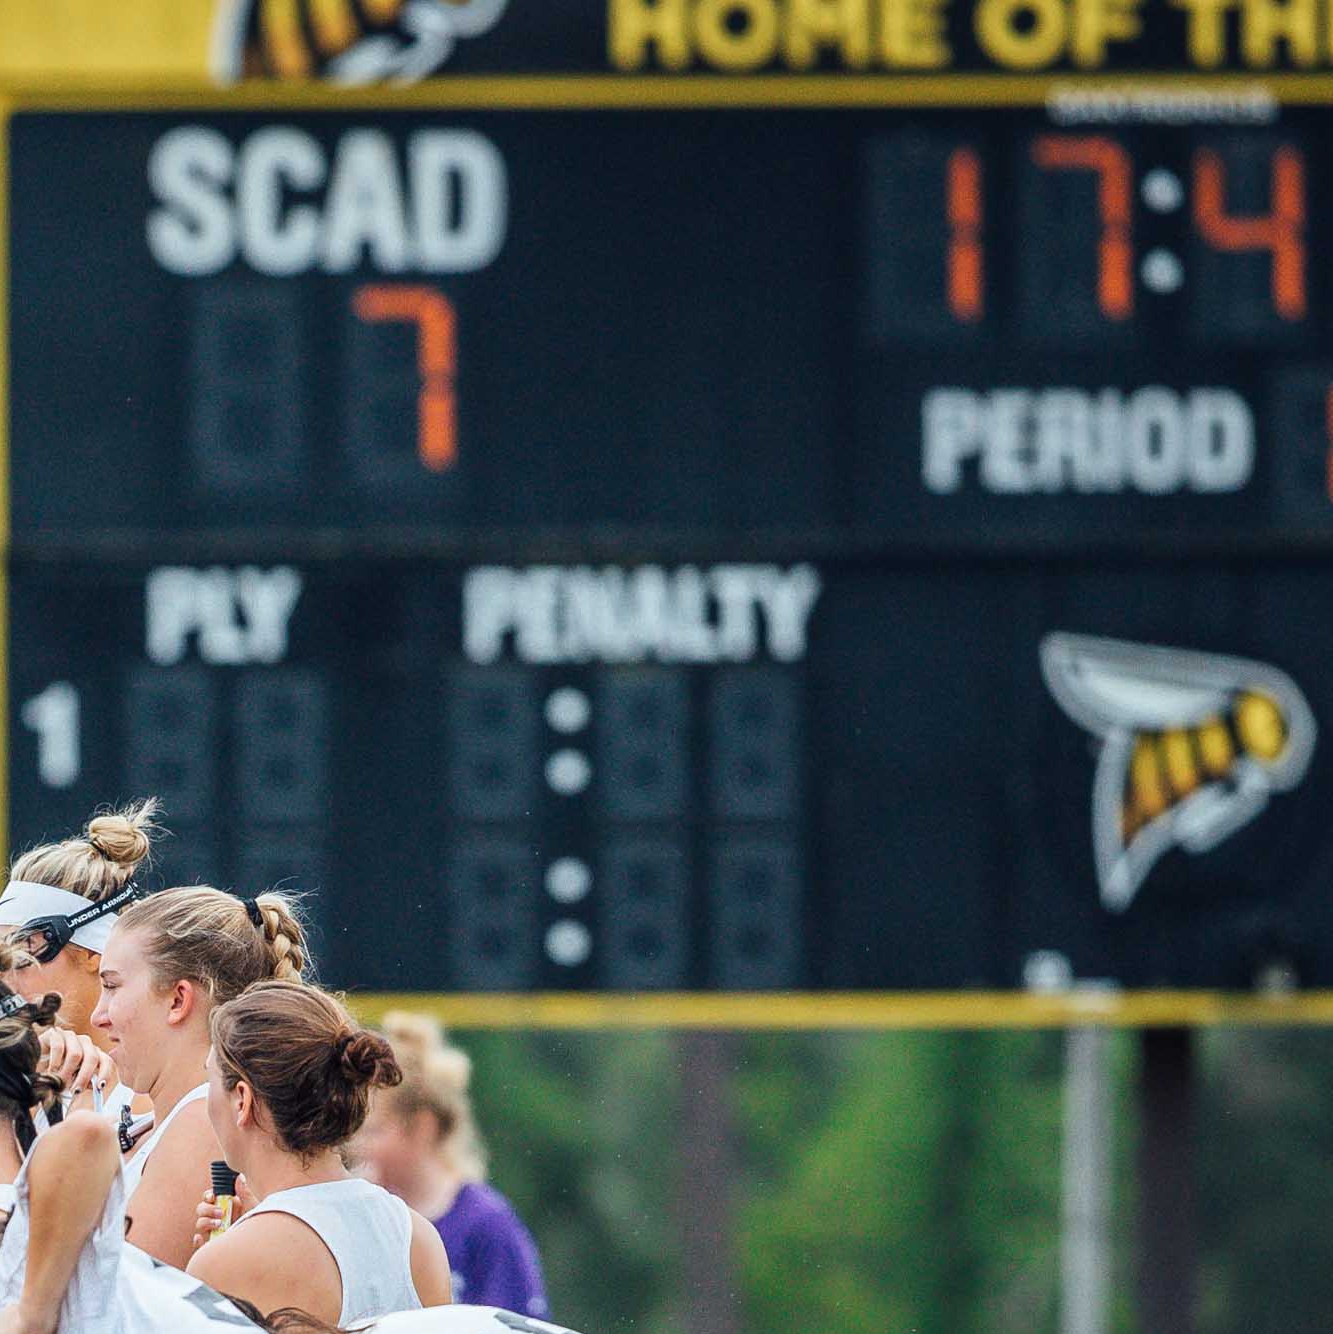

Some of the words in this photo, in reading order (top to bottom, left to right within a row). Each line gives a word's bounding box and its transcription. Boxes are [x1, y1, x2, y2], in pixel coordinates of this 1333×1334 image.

[607, 0, 949, 69] HOME
[974, 0, 1140, 69] OF
[1169, 0, 1333, 67] TH
[148, 129, 504, 275] SCAD
[354, 286, 457, 471] 7
[922, 389, 1254, 493] PERIOD
[145, 567, 302, 664] PLY
[462, 564, 819, 665] PENALTY
[22, 683, 81, 787] 1
[64, 907, 100, 928] UNDER
